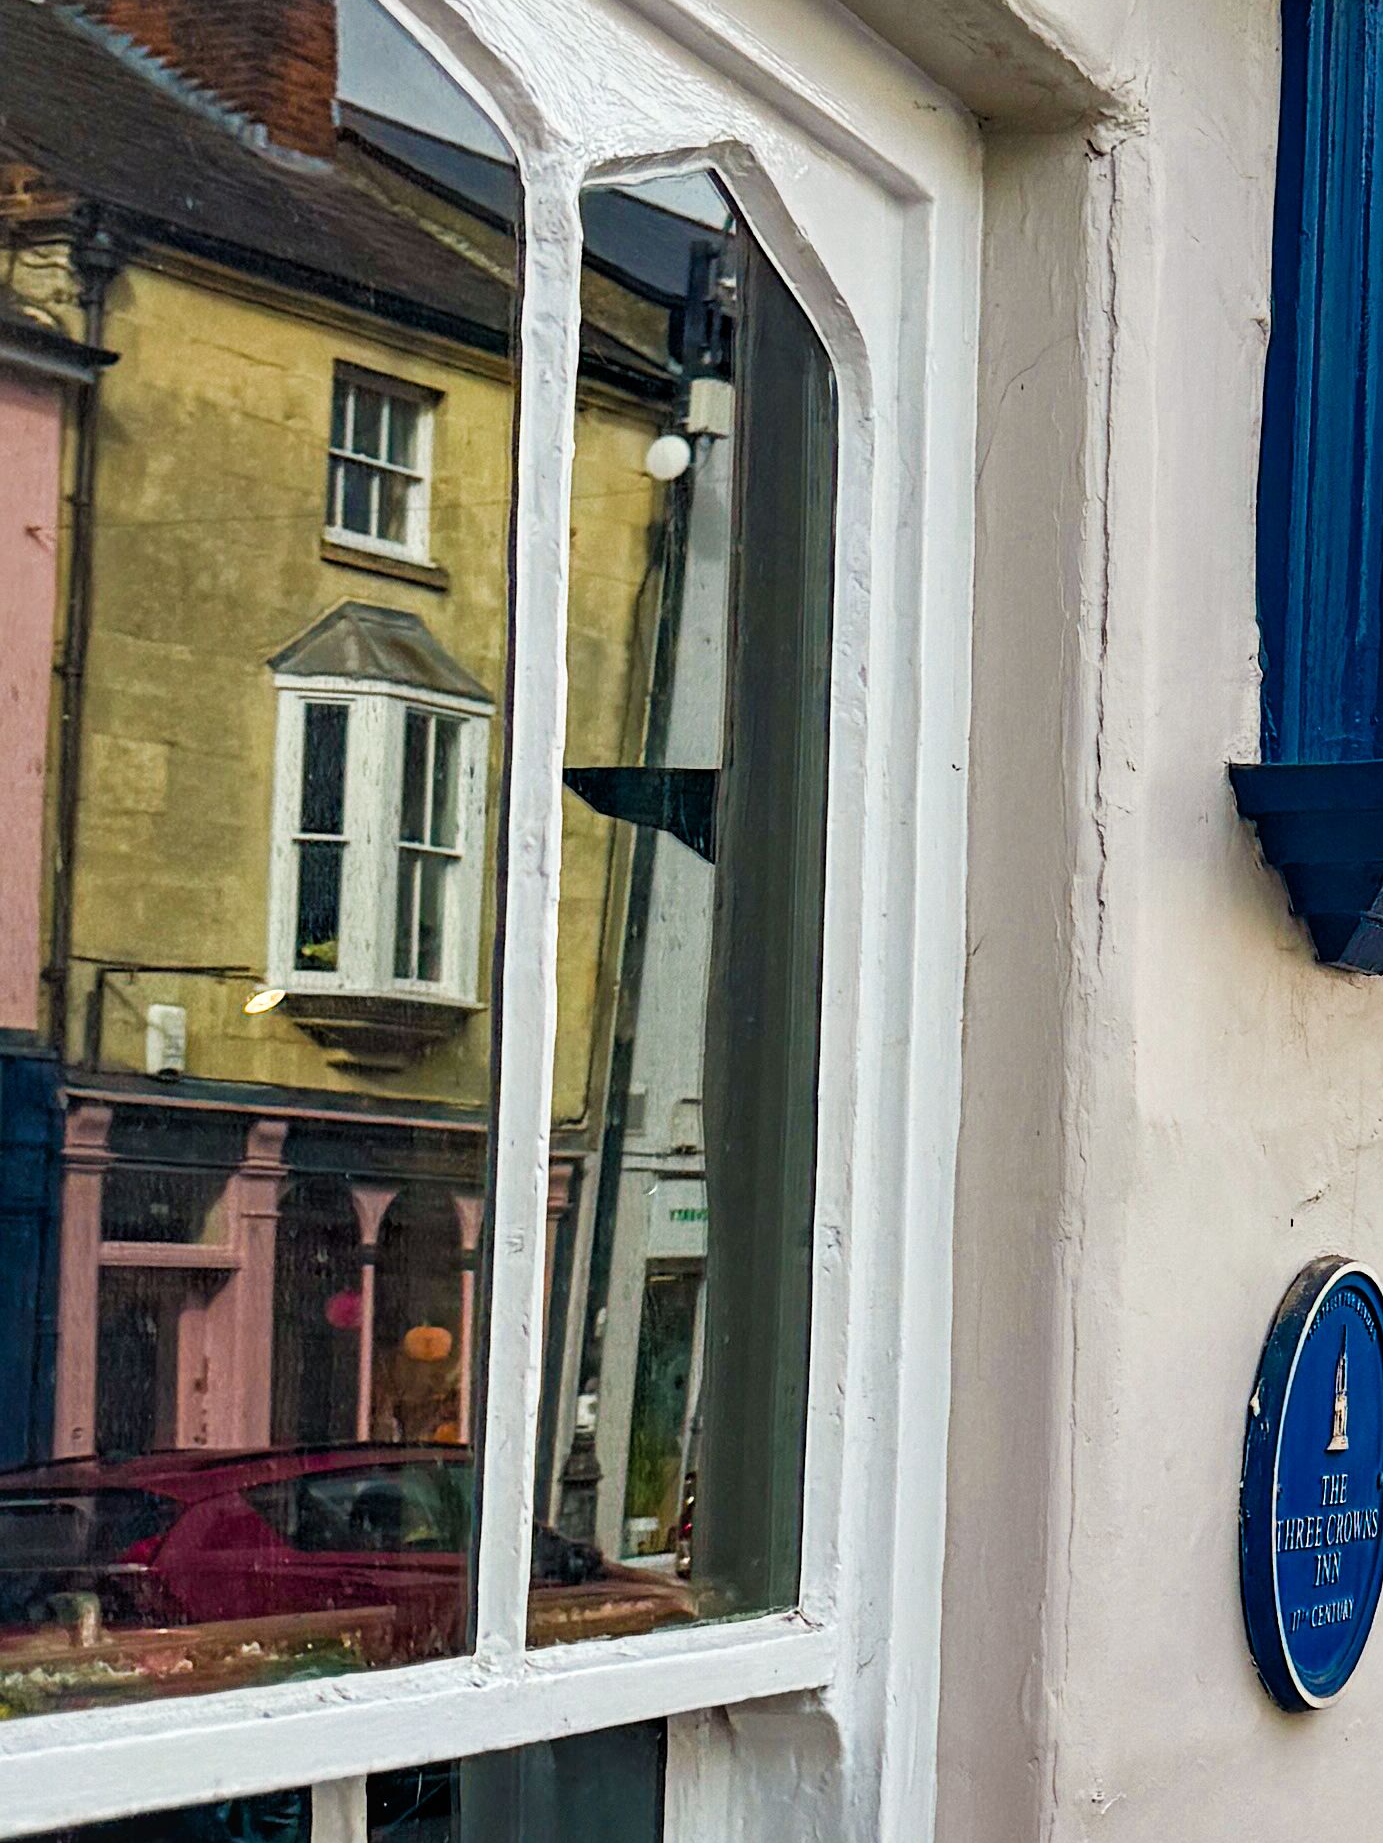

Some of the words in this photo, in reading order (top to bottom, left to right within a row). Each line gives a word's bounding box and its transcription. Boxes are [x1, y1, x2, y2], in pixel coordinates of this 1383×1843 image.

[1322, 1474, 1349, 1505] THE
[1277, 1516, 1323, 1552] THREE
[1326, 1509, 1379, 1546] CROWNS
[1315, 1552, 1342, 1586] INN
[1311, 1598, 1355, 1627] CENTURY
